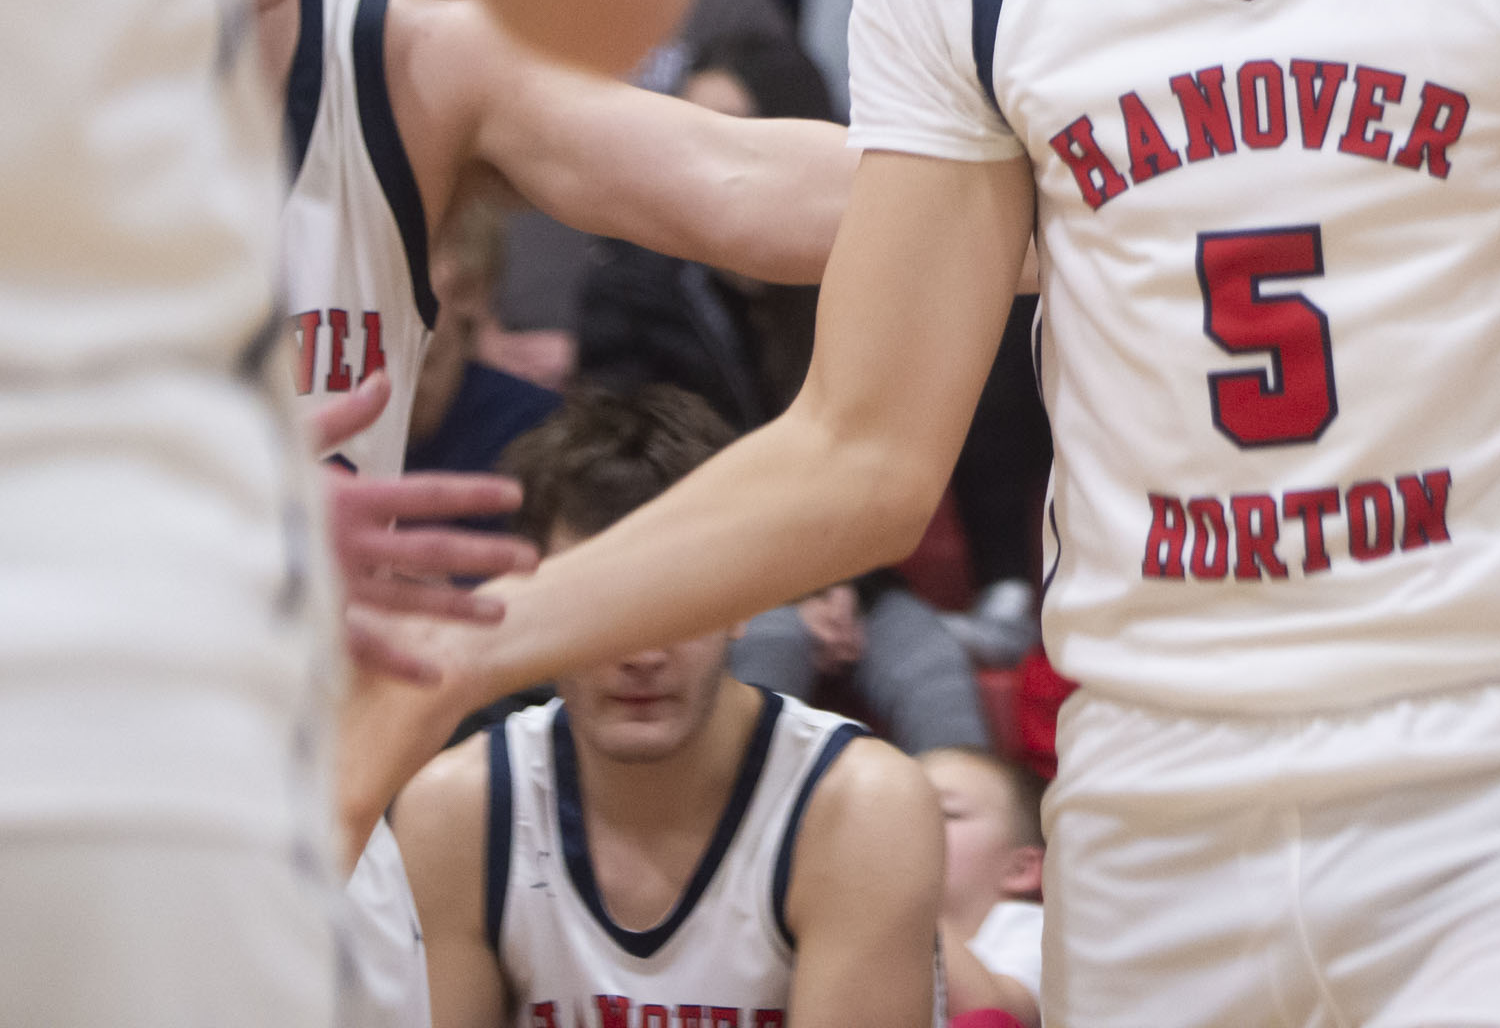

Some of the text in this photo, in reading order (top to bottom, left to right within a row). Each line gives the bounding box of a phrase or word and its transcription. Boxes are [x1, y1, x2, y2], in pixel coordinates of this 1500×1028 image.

[1048, 57, 1471, 211] HANOVER
[1195, 223, 1339, 452] 5
[1141, 467, 1453, 582] HORTON
